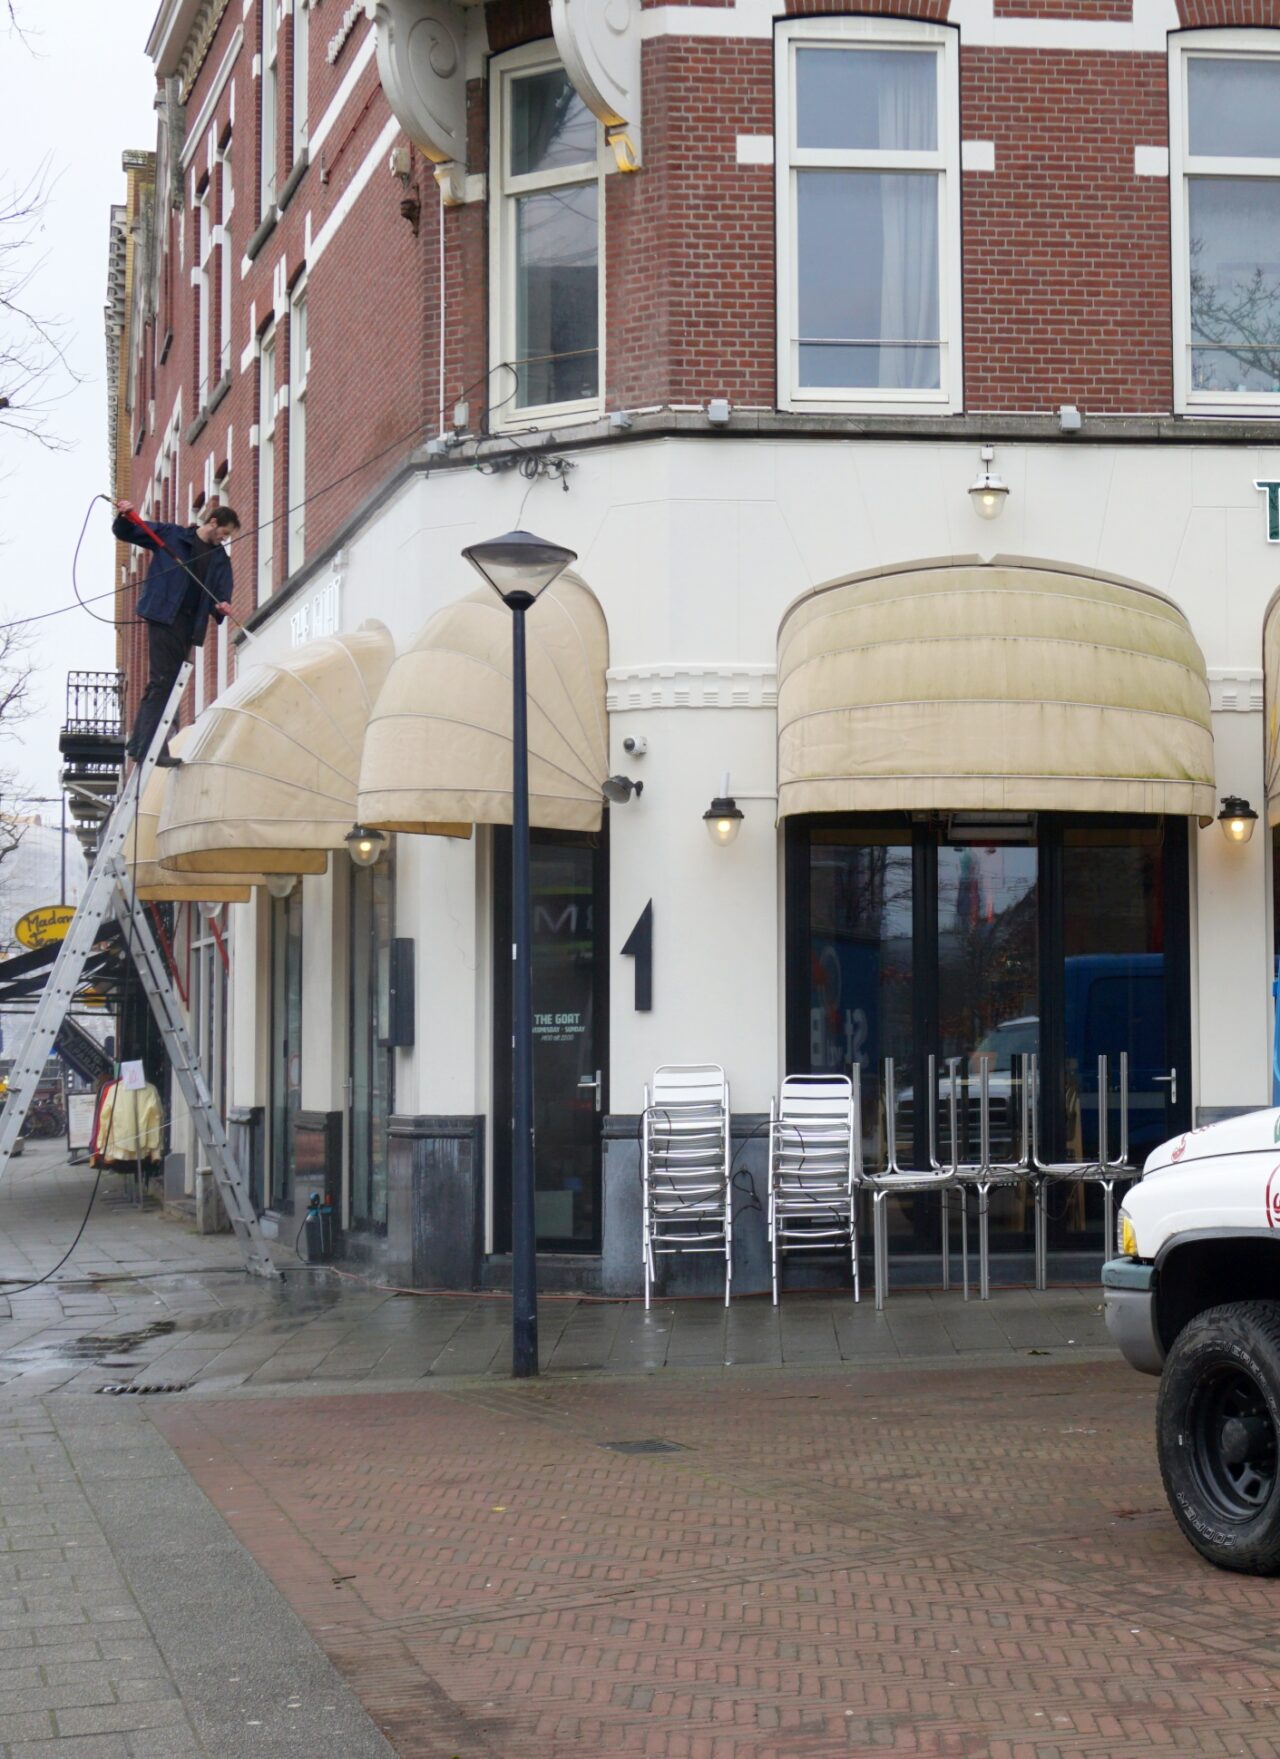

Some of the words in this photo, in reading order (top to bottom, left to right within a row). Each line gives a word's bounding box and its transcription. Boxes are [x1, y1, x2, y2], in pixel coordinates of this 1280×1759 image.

[534, 1014, 553, 1025] THE
[555, 1013, 581, 1024] GOAT
[1177, 1492, 1237, 1546] COOPER
